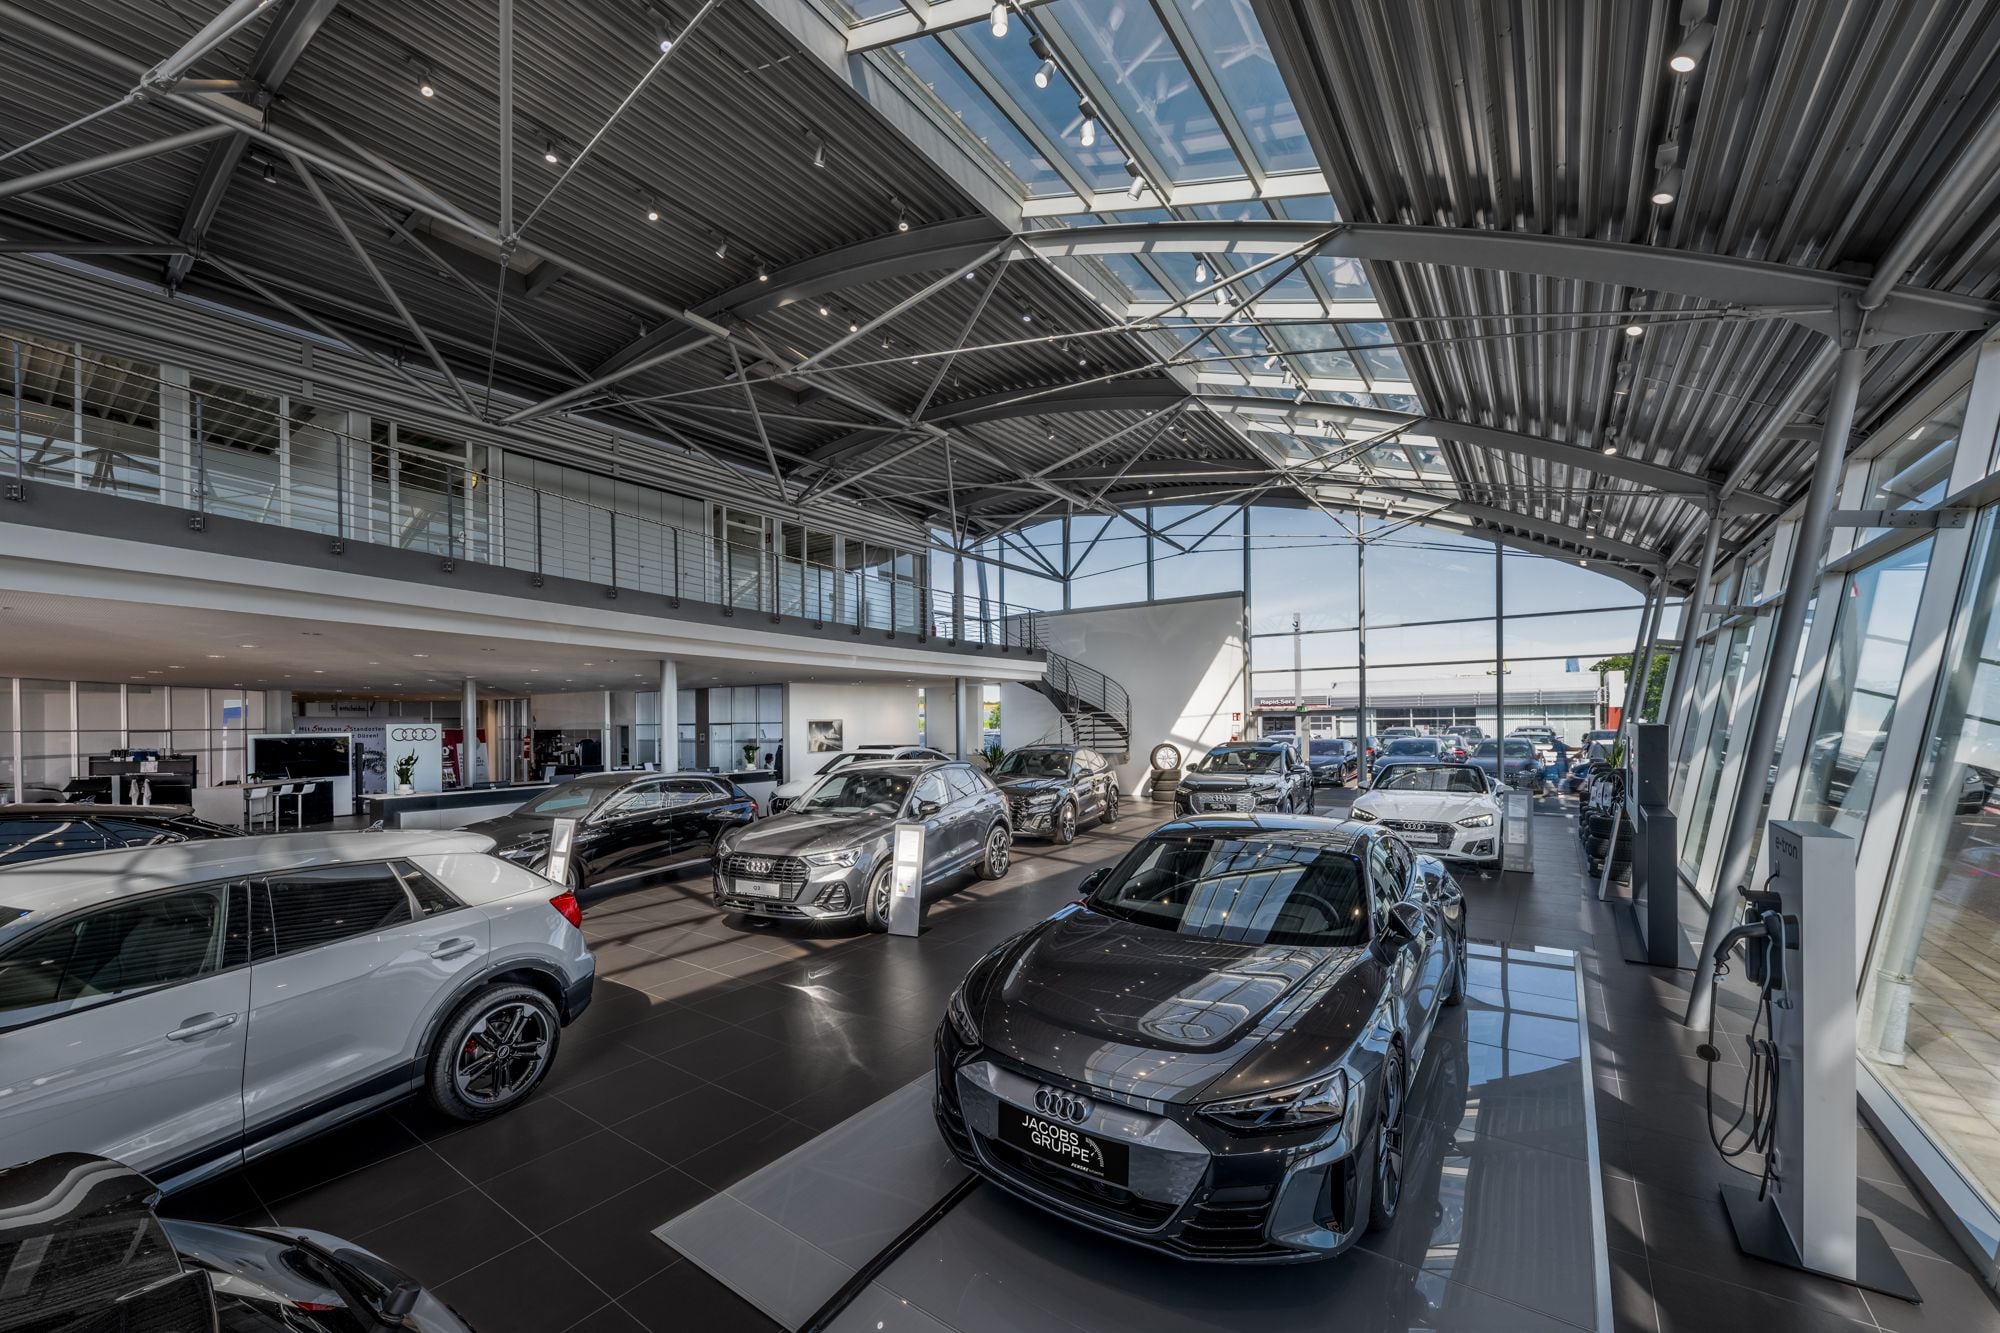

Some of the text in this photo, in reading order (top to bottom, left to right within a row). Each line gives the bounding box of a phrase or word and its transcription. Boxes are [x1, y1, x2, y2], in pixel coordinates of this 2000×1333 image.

[1776, 836, 1798, 860] e-tron
[1022, 1115, 1079, 1146] JACOBS
[1031, 1131, 1090, 1163] GRUPPE
